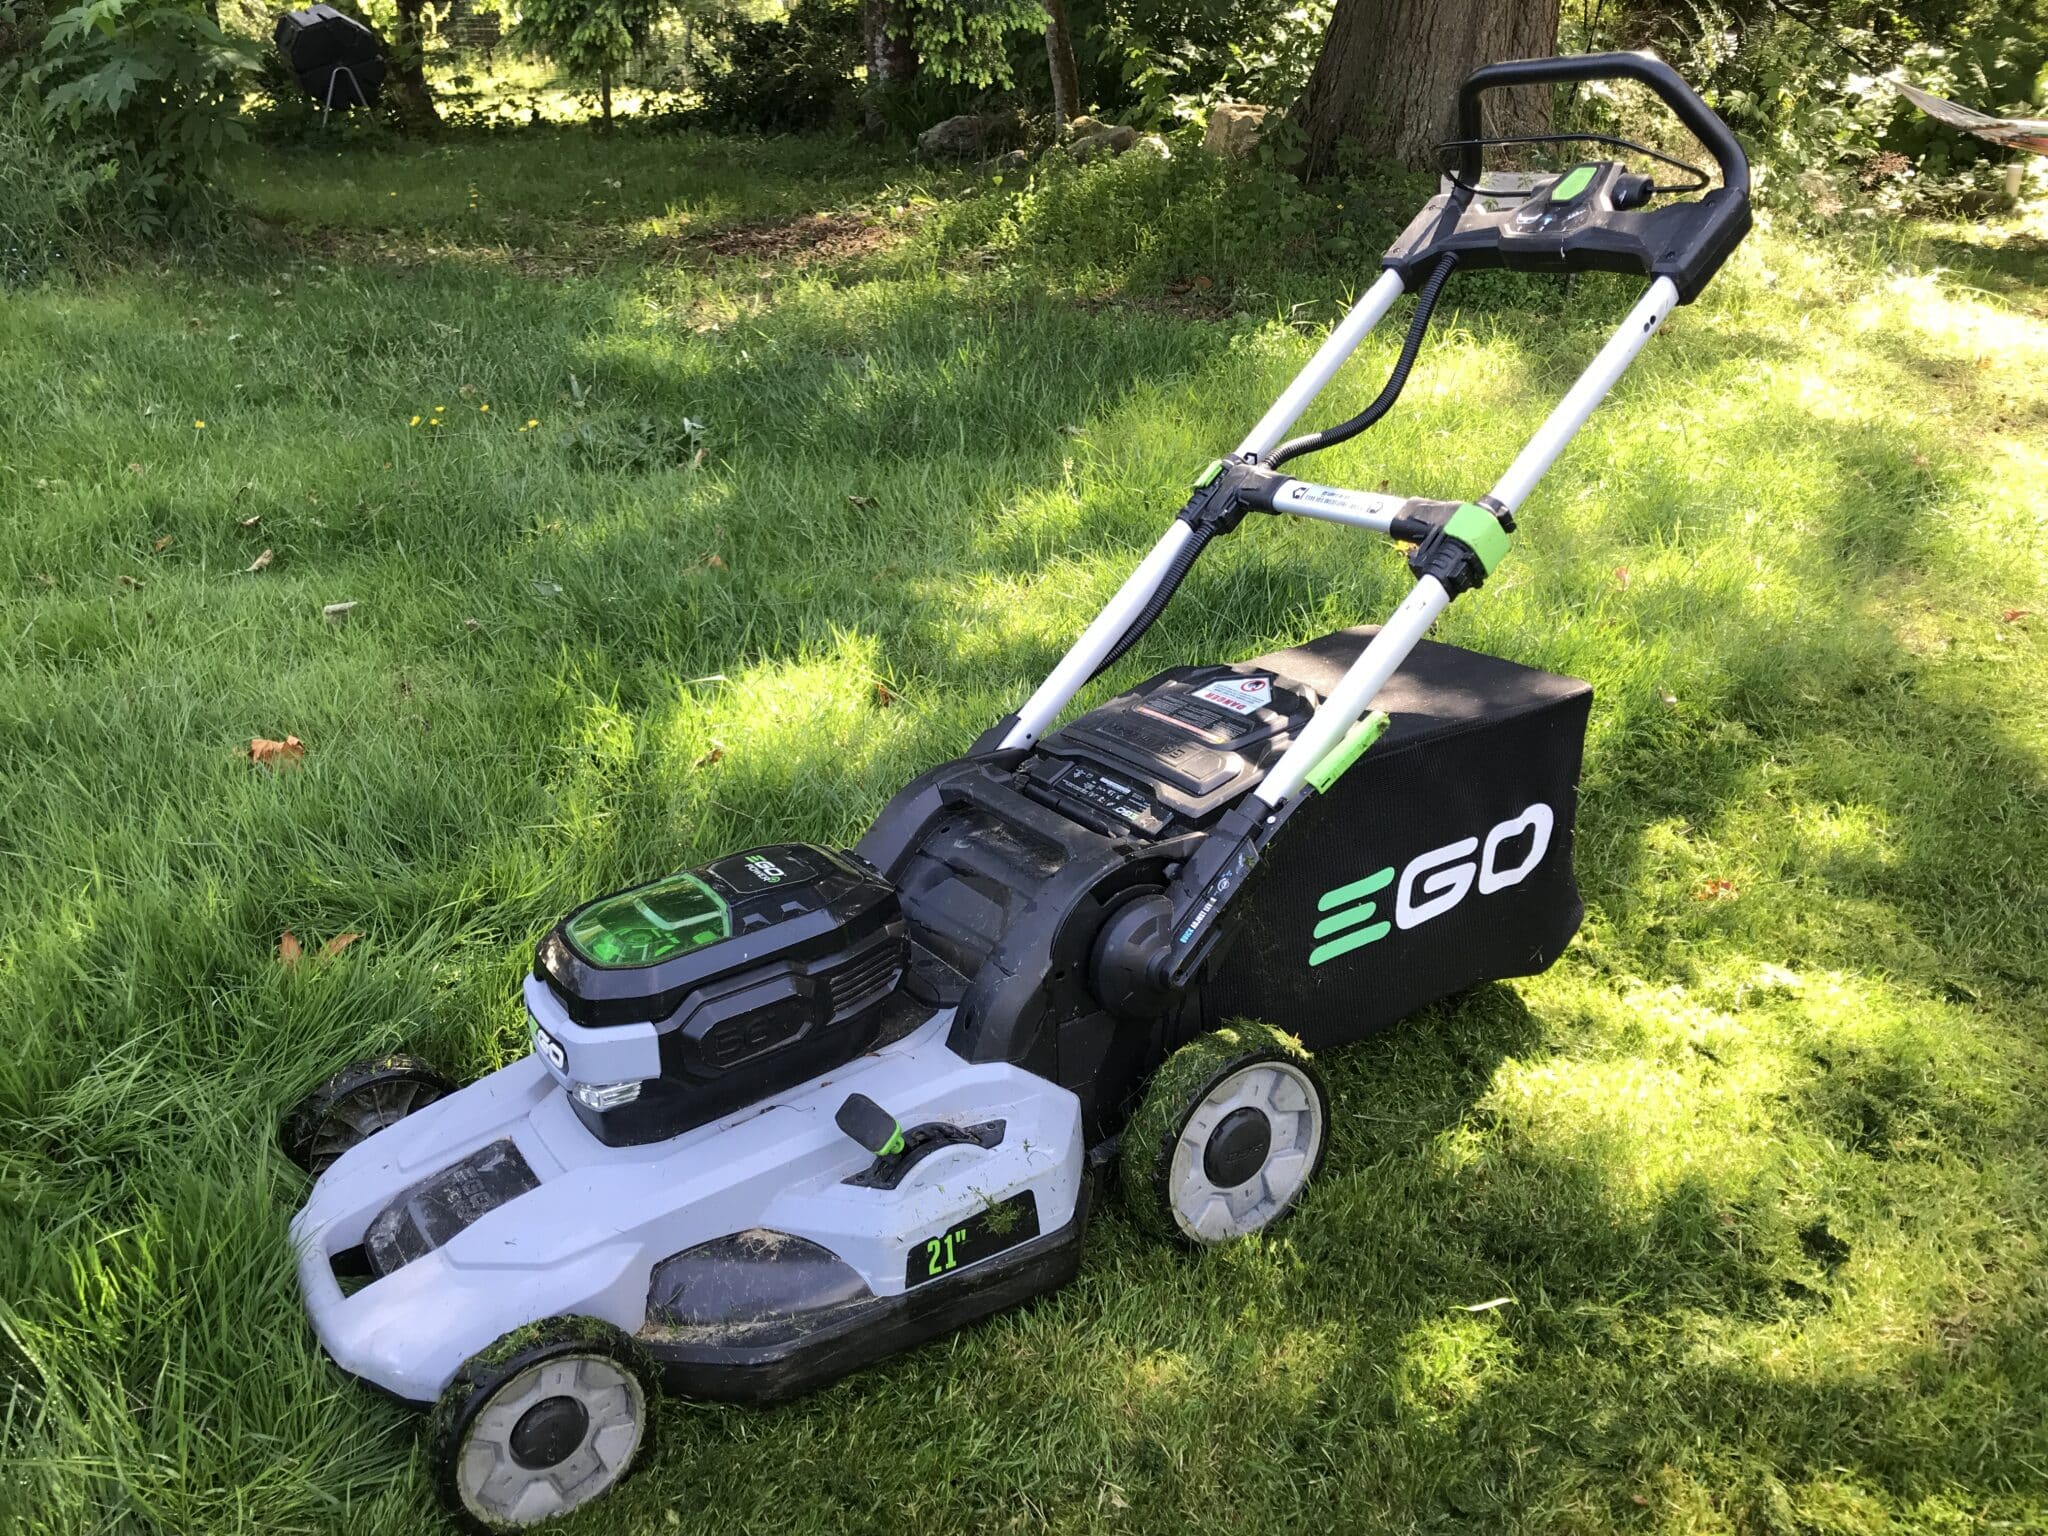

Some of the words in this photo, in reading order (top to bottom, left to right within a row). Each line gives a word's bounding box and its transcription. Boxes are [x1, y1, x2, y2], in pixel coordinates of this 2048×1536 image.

[744, 854, 785, 877] EGO
[1308, 801, 1554, 968] EGO
[927, 1229, 967, 1276] 21"
